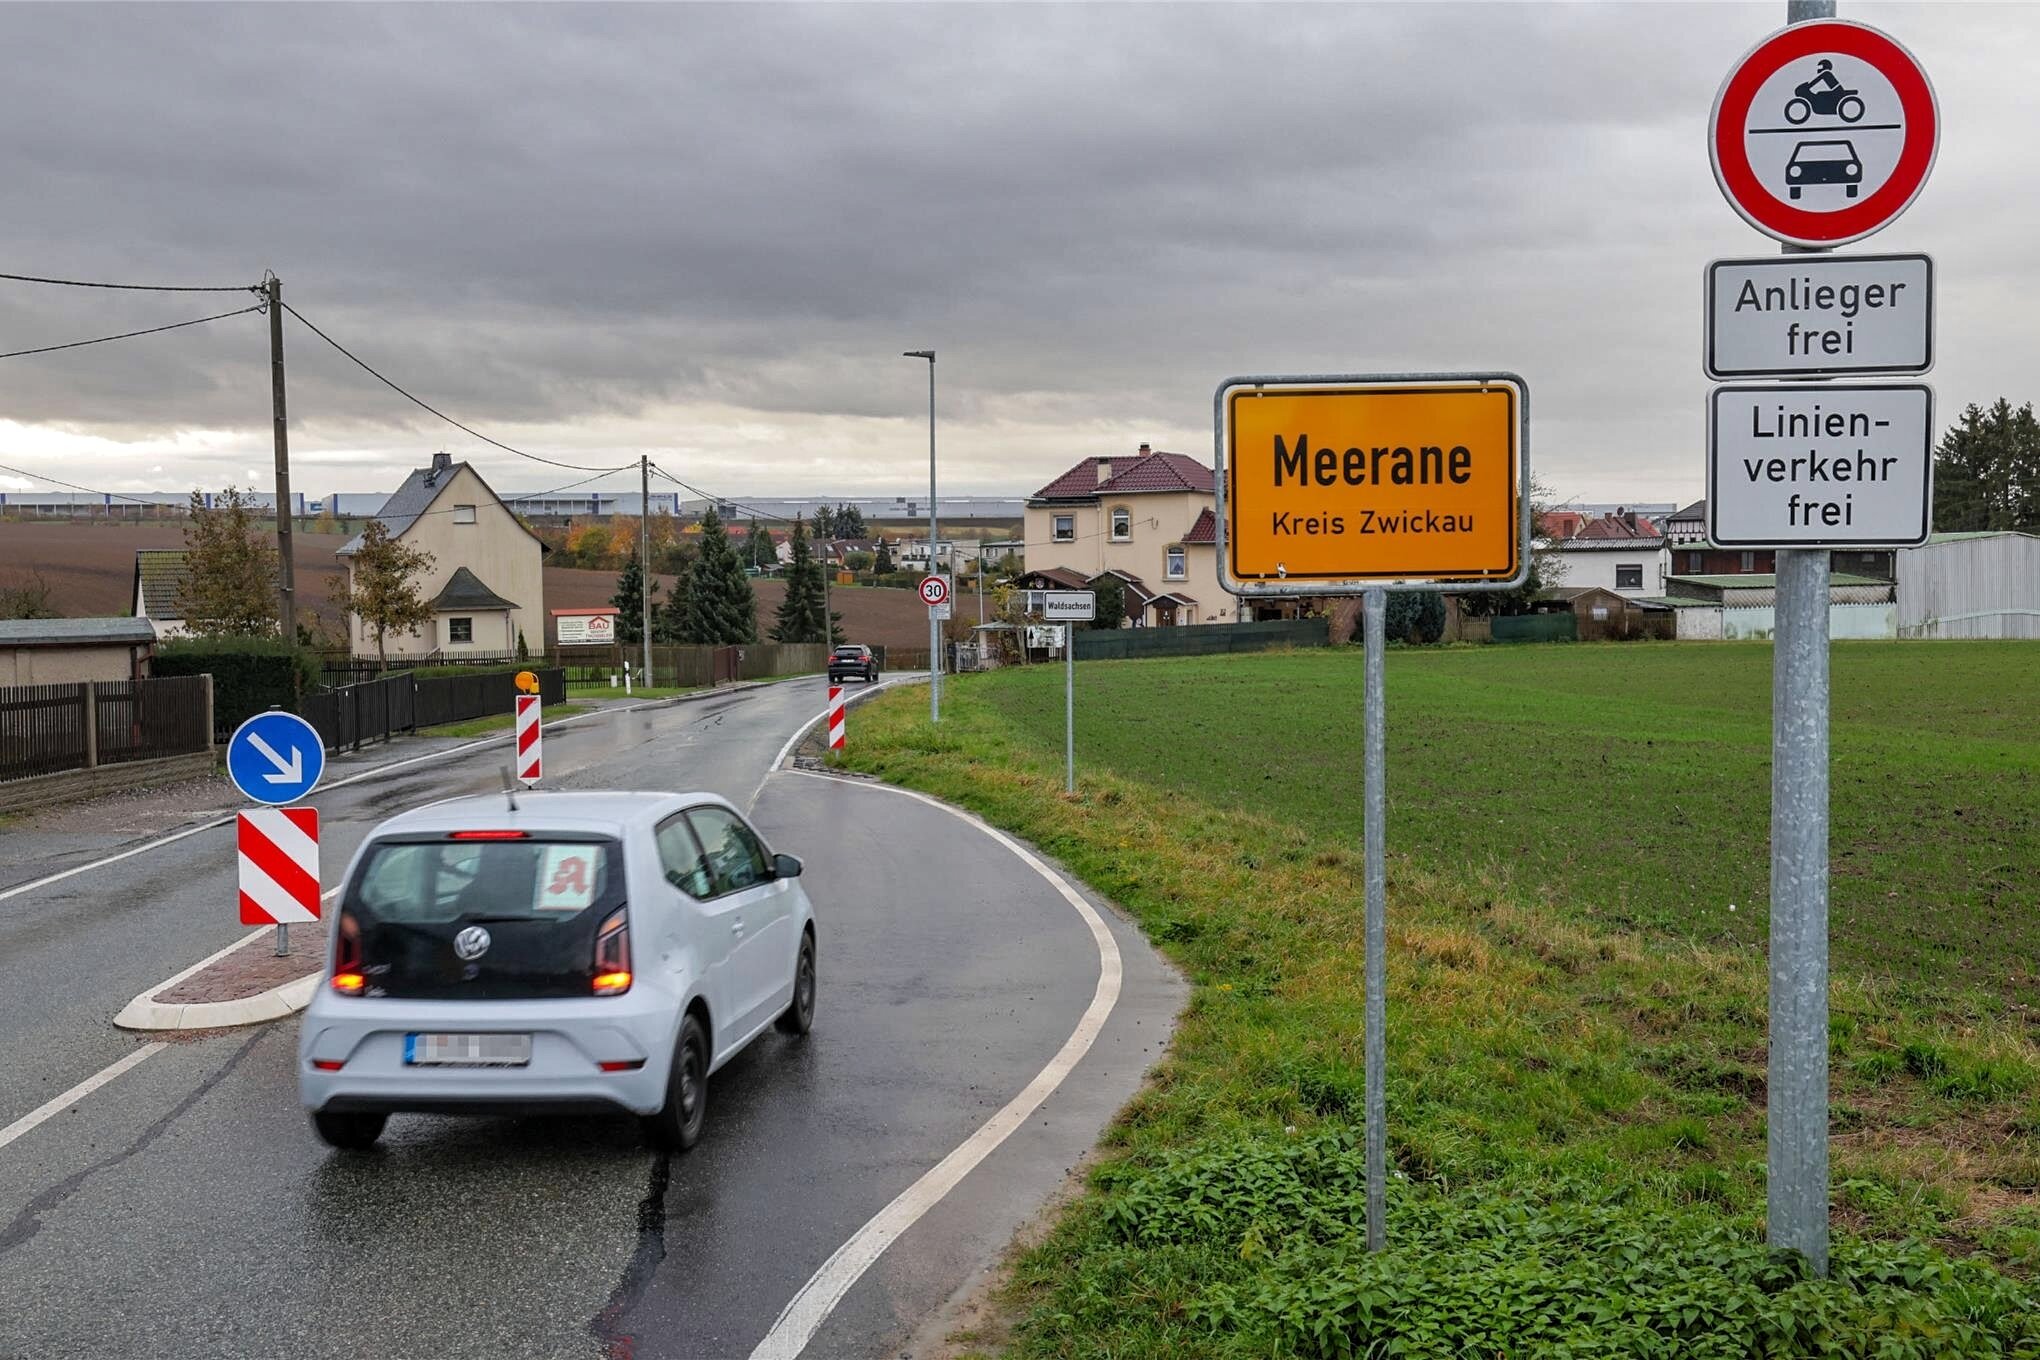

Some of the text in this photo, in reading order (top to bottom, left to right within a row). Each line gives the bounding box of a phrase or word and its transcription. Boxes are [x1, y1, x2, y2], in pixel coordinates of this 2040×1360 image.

[1734, 277, 1906, 318] Anlieger
[1787, 321, 1853, 355] frei
[1753, 405, 1890, 438] Linien-
[1273, 433, 1472, 487] Meerane
[1743, 449, 1898, 482] verkehr
[1272, 509, 1474, 536] Kreis Zwickau
[1788, 494, 1852, 526] frei
[925, 584, 942, 598] 30
[1047, 601, 1092, 611] Waldsachsen
